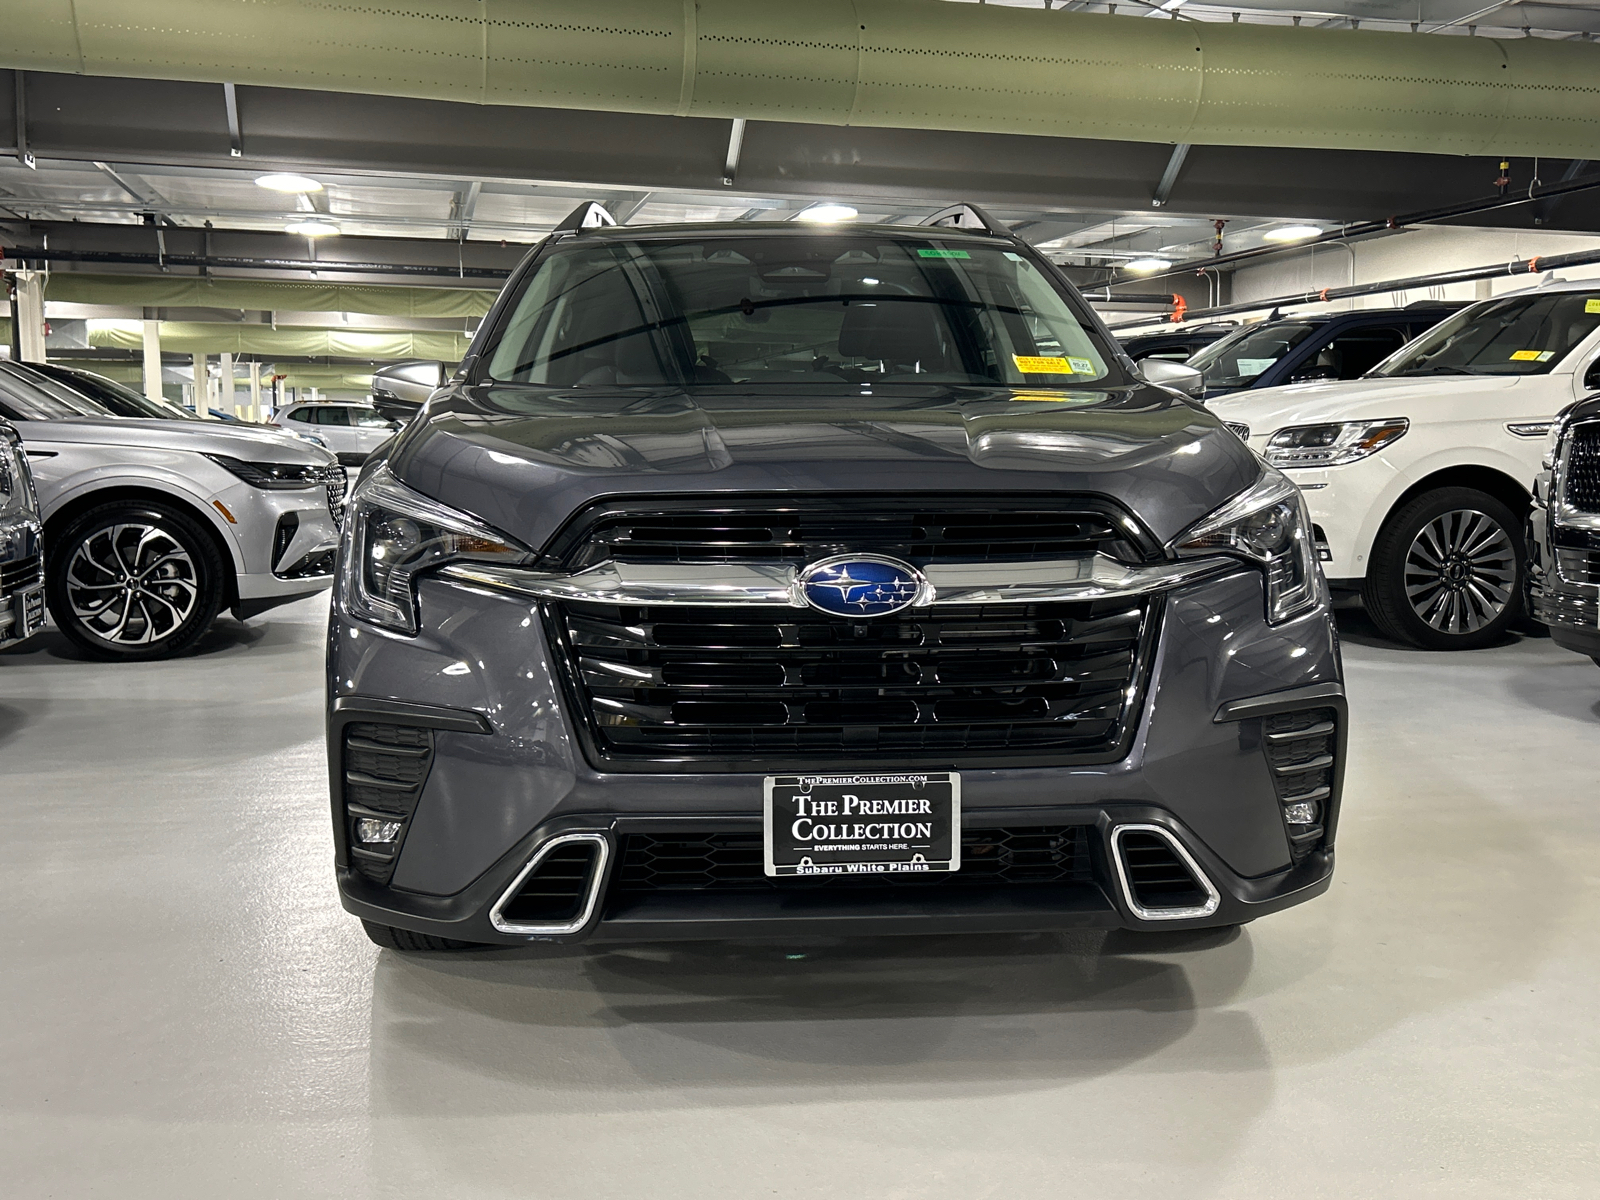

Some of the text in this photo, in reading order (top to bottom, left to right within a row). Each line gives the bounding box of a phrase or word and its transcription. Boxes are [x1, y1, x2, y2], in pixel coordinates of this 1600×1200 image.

[792, 794, 932, 816] THE PREMIER
[792, 818, 932, 840] COLLECTION
[796, 862, 930, 875] Subaru White Plains
